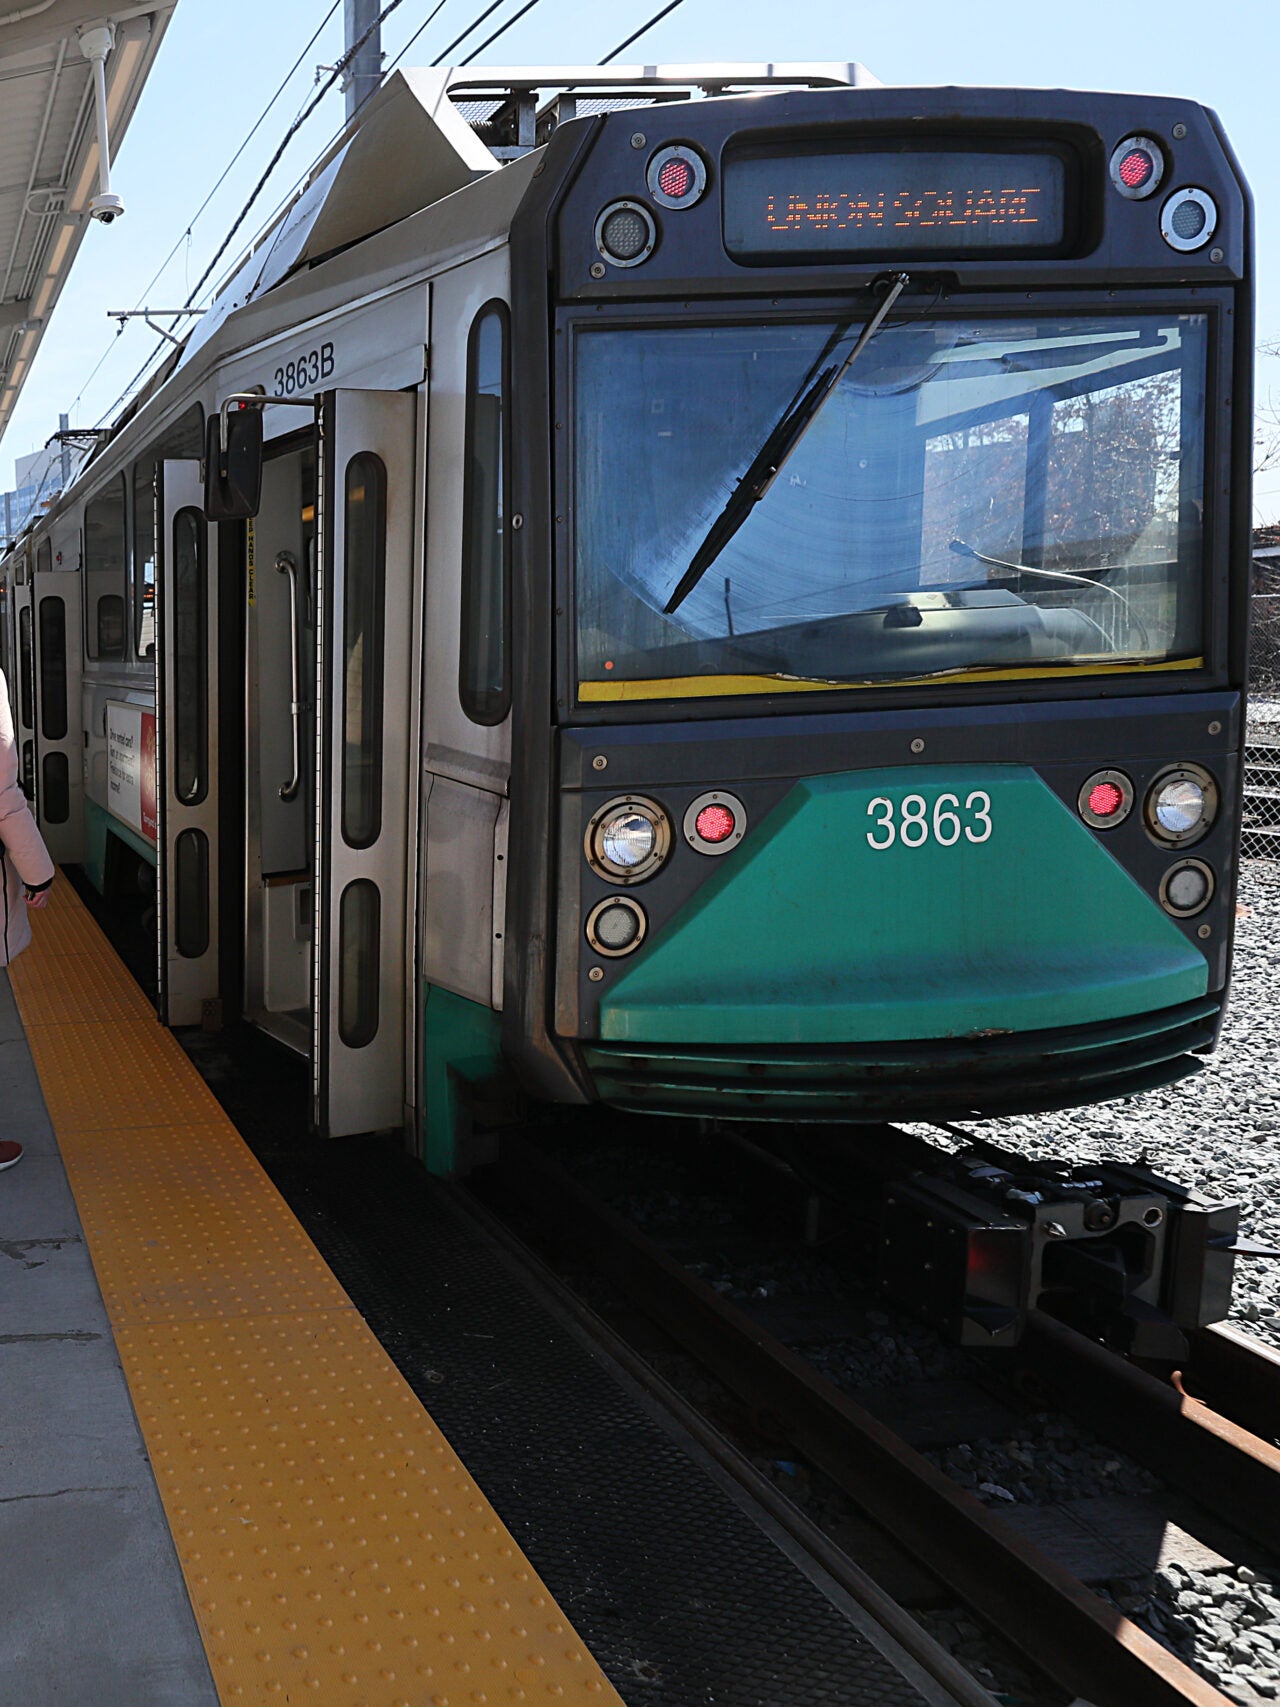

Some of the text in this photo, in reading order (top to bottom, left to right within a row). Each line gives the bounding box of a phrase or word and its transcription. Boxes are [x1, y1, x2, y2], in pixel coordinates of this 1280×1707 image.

[767, 188, 1041, 230] UNION SQUARE
[274, 341, 335, 398] 3863B
[866, 790, 993, 850] 3863
